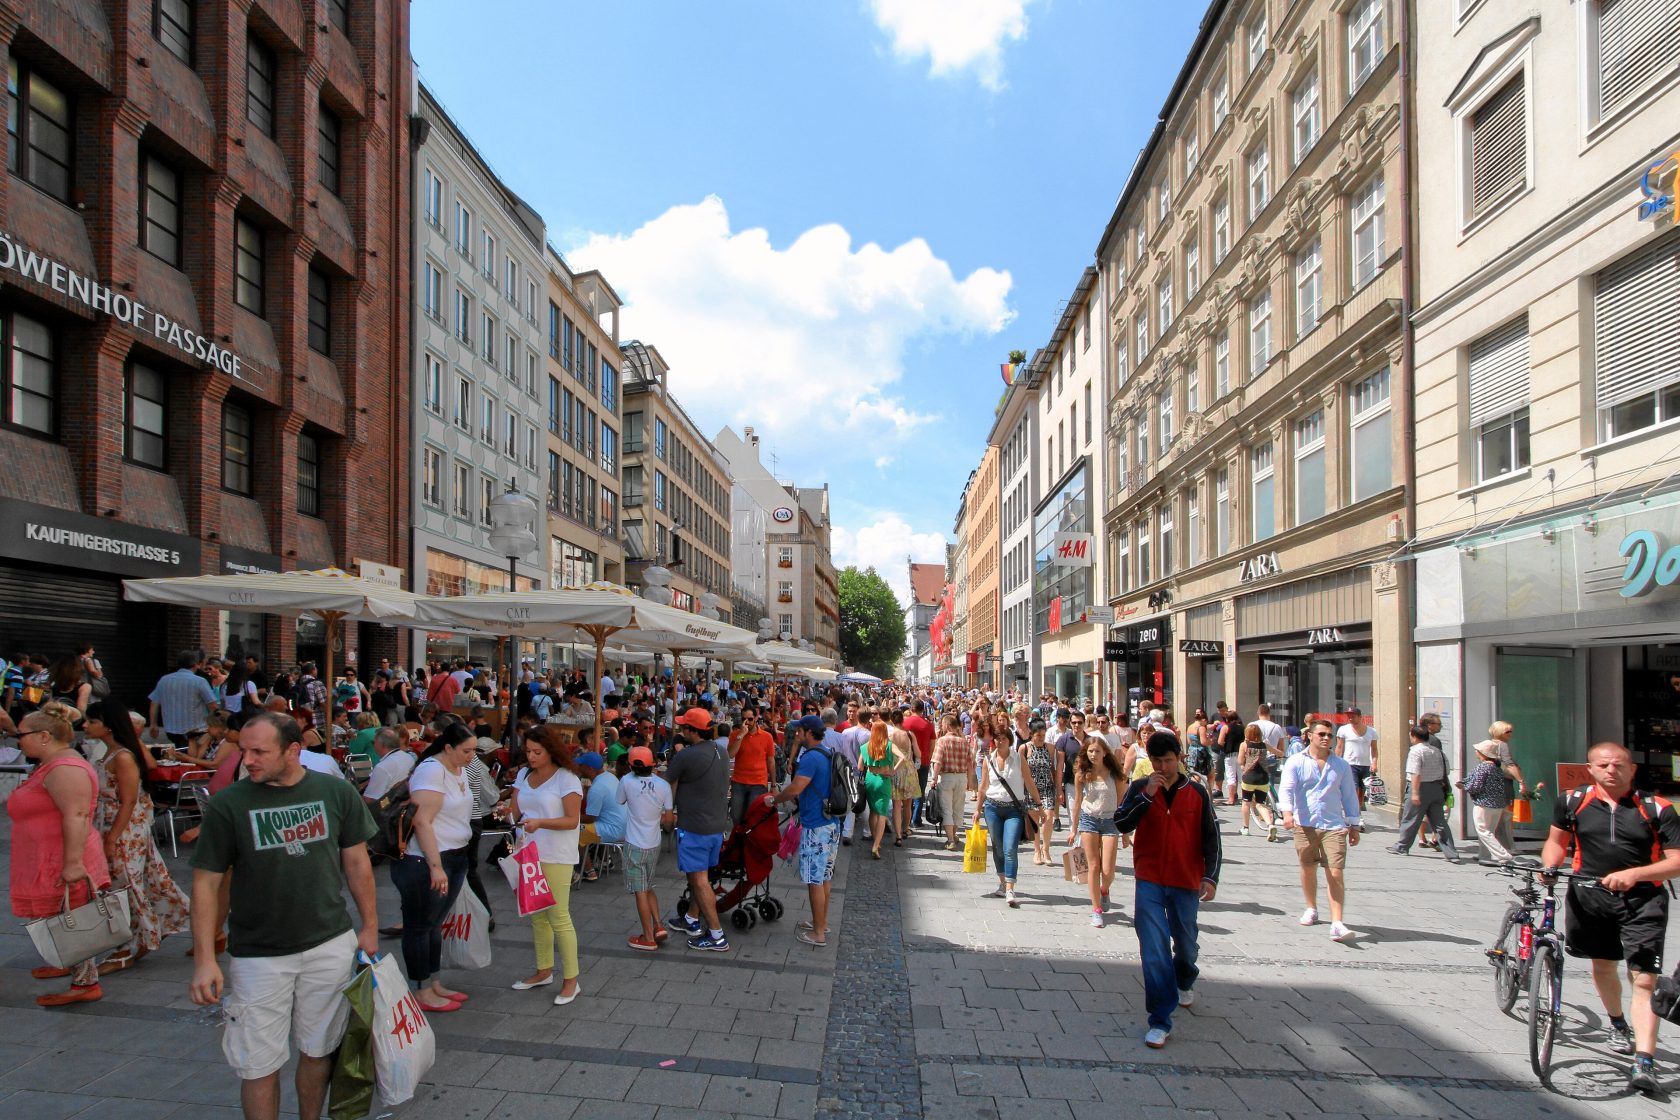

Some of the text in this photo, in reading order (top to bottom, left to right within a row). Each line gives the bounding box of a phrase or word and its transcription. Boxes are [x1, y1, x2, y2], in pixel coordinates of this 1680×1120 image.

[154, 312, 242, 380] PASSAGE
[25, 522, 180, 565] KAUFINGERSTRASSE 5
[1058, 539, 1087, 559] H&M
[1239, 551, 1280, 582] ZARA
[1139, 627, 1158, 643] zero
[1181, 640, 1220, 652] ZARA
[1307, 627, 1341, 645] ZARA
[391, 990, 427, 1050] H&M
